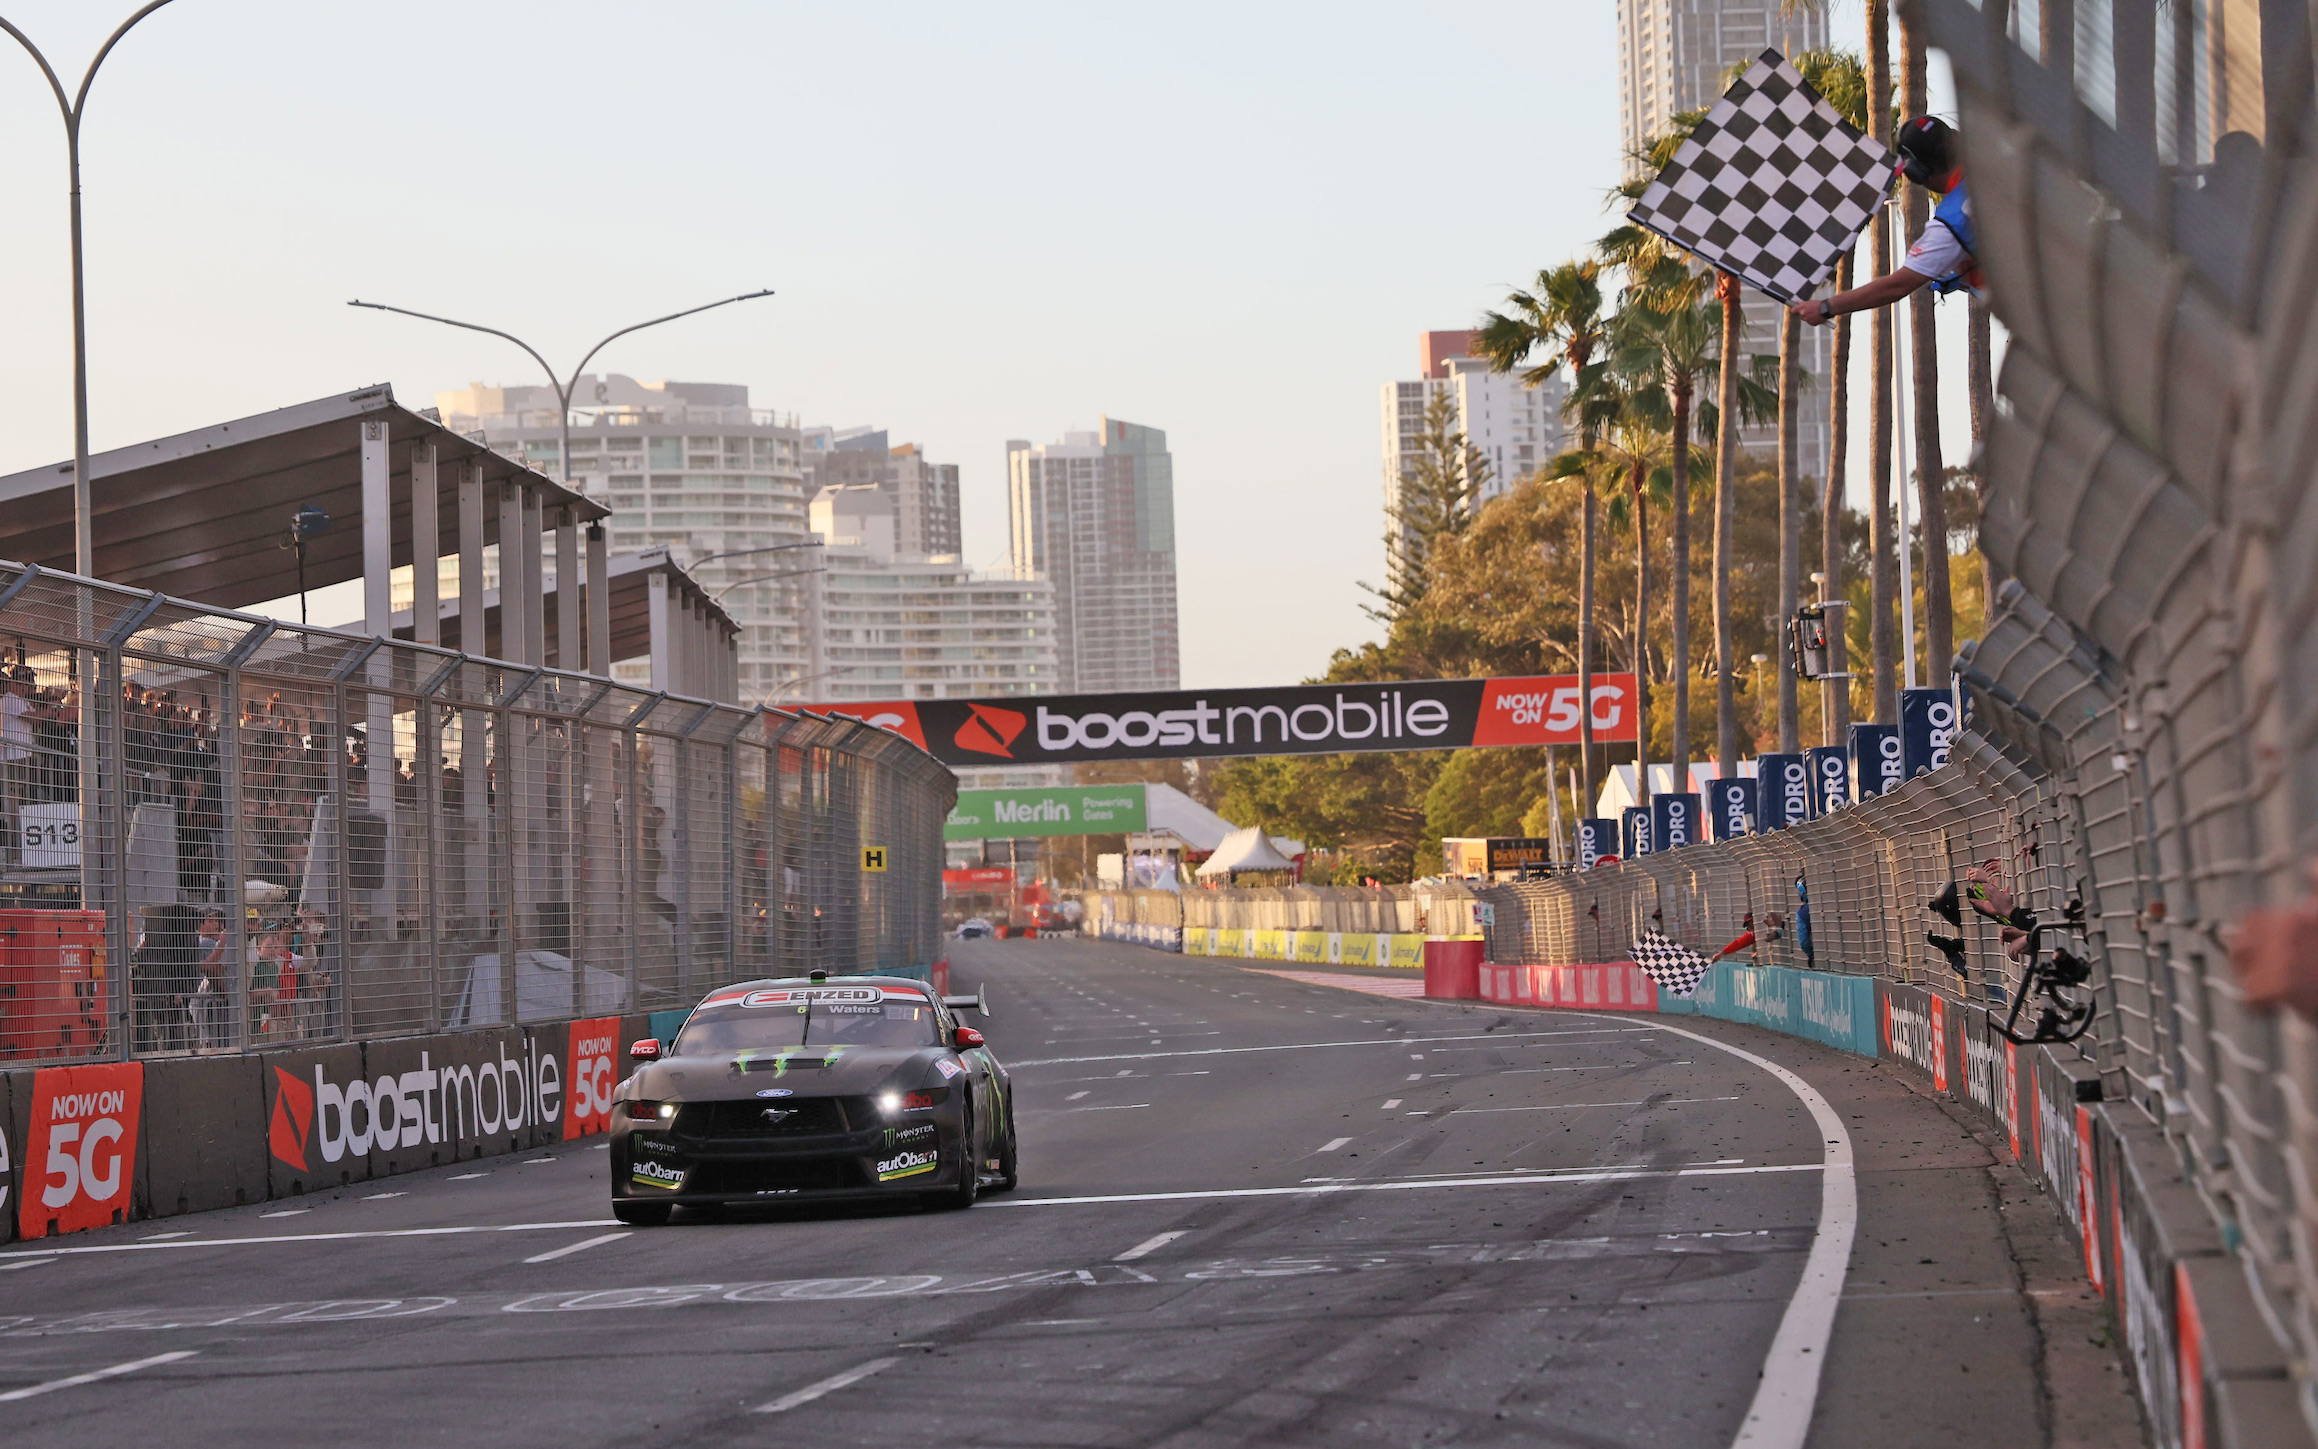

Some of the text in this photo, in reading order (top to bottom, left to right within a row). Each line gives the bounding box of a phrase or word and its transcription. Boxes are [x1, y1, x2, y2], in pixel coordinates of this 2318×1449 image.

[1496, 692, 1548, 711] NOW
[1544, 685, 1624, 732] 5G
[1036, 691, 1449, 751] boostmobile
[1512, 709, 1542, 724] ON
[994, 799, 1071, 823] Merlin
[1082, 796, 1134, 810] Powering
[26, 823, 78, 846] S13
[866, 851, 882, 867] H
[790, 991, 869, 1000] ENZED
[797, 1006, 807, 1014] 6
[829, 1005, 880, 1014] Waters
[578, 1036, 612, 1056] NOW ON
[575, 1055, 611, 1118] 5G
[51, 1090, 124, 1120] NOW ON
[315, 1037, 560, 1162] boostmobile
[902, 1091, 932, 1108] dba
[41, 1117, 124, 1208] 5G
